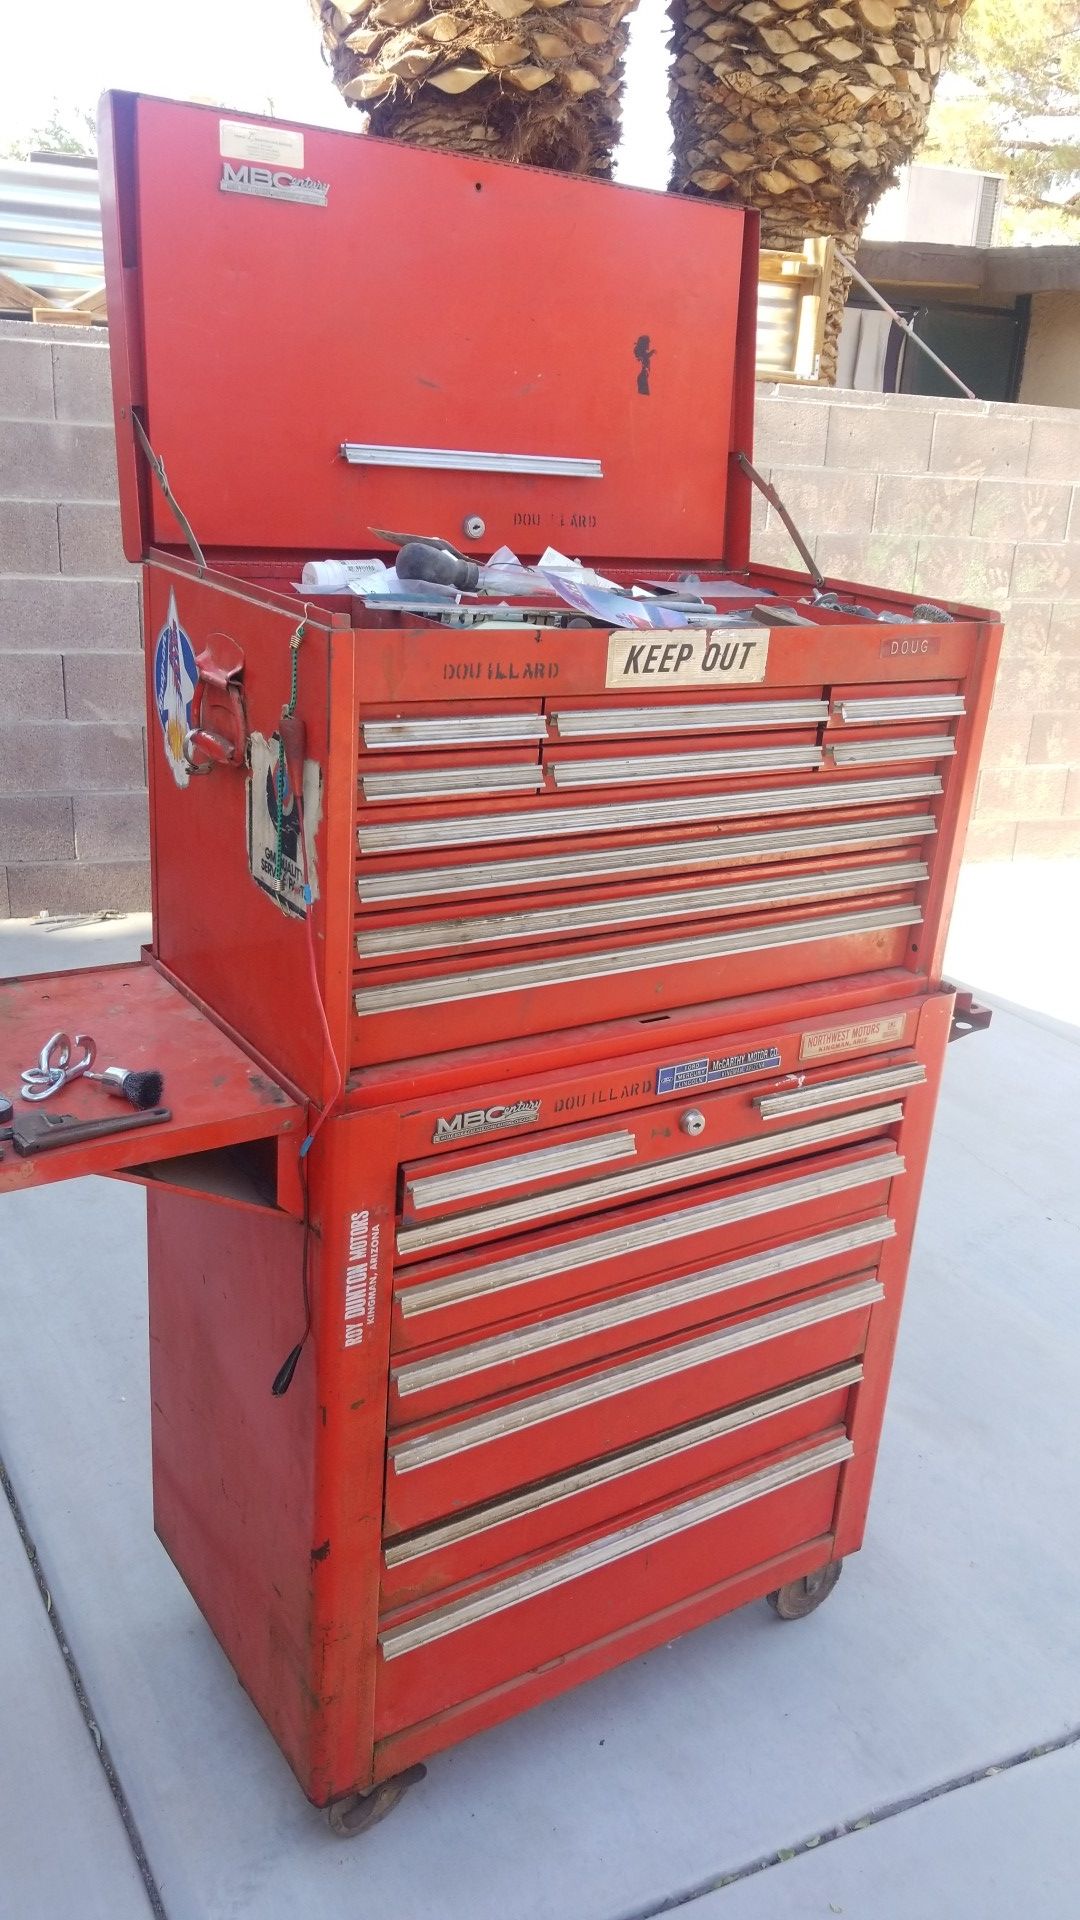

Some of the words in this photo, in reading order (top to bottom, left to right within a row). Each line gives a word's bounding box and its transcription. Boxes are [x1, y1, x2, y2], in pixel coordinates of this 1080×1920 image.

[623, 643, 694, 675] KEEP
[701, 641, 758, 672] OUT
[890, 639, 929, 655] DOUG
[807, 1029, 849, 1048] NORTHWEST
[851, 1023, 881, 1038] MOTORS
[684, 1063, 700, 1072] FORD
[712, 1054, 746, 1071] McCARTHY
[747, 1049, 768, 1062] MOTOR
[676, 1069, 706, 1080] MERCURY
[677, 1078, 703, 1088] LINCOLN
[554, 1080, 652, 1113] DOUILLARD
[349, 1210, 369, 1261] MOTORS
[369, 1223, 380, 1270] ARIZONA
[344, 1262, 368, 1320] DUNTON
[367, 1273, 378, 1325] KINGMAN,
[344, 1322, 363, 1347] ROY
